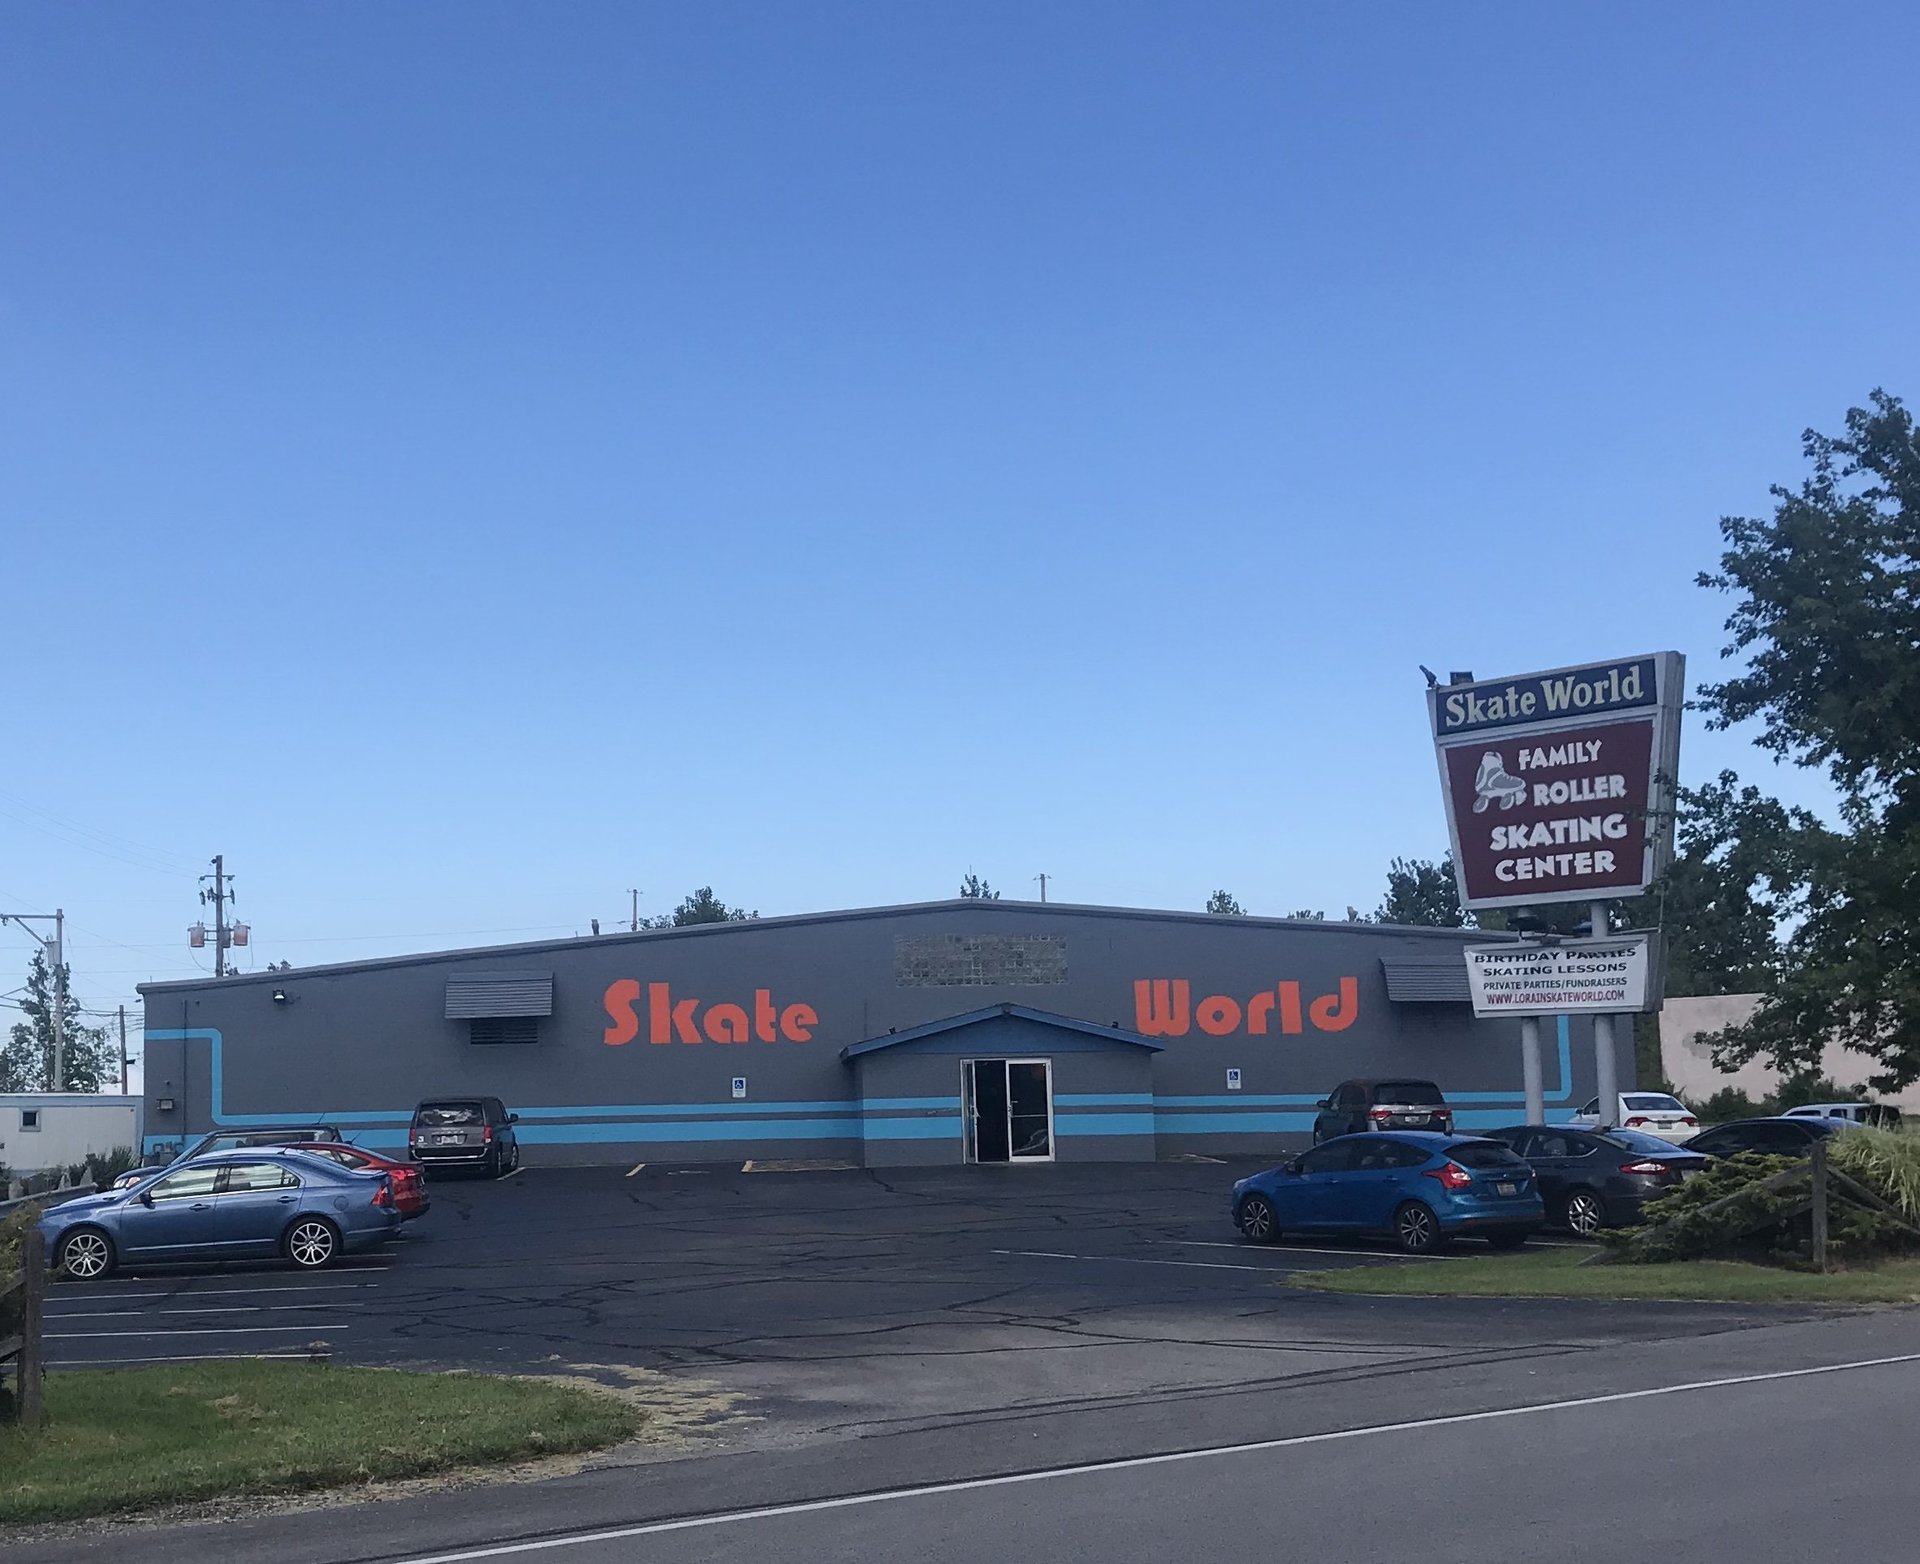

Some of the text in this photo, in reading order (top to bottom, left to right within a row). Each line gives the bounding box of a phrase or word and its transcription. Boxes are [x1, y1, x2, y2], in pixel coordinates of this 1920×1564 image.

[1446, 665, 1644, 727] Skate World
[1518, 739, 1602, 770] FAMILY
[1533, 774, 1628, 806] ROLLER
[1490, 813, 1628, 850] SKATING
[1495, 850, 1617, 882] CENTER
[1474, 947, 1636, 963] BIRTHDAY PARTIES
[1483, 962, 1628, 977] SKATING LESSONS
[1483, 976, 1628, 991] PRIVATE PARTIES/FUNDRAISERS
[1486, 990, 1625, 1005] WWW.LORAINSKATEWORLD.COM
[604, 976, 1358, 1046] Skate World
